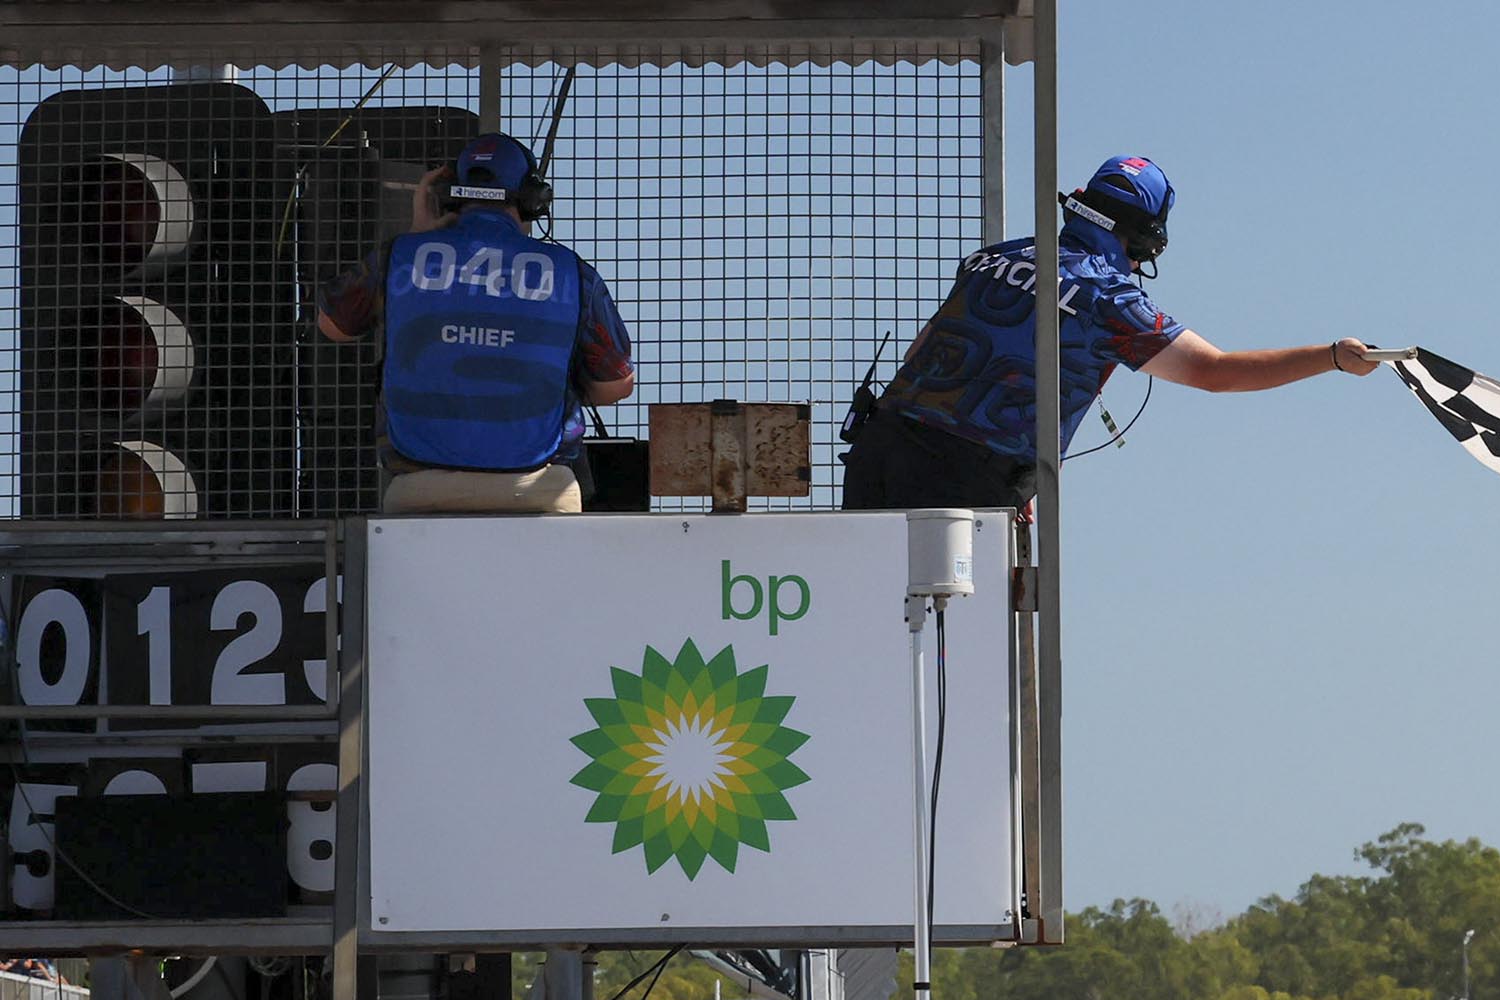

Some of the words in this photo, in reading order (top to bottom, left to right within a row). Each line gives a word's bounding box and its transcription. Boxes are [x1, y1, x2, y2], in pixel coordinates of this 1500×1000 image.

[411, 242, 554, 301] 040
[441, 325, 515, 347] CHIEF
[721, 560, 811, 636] bp
